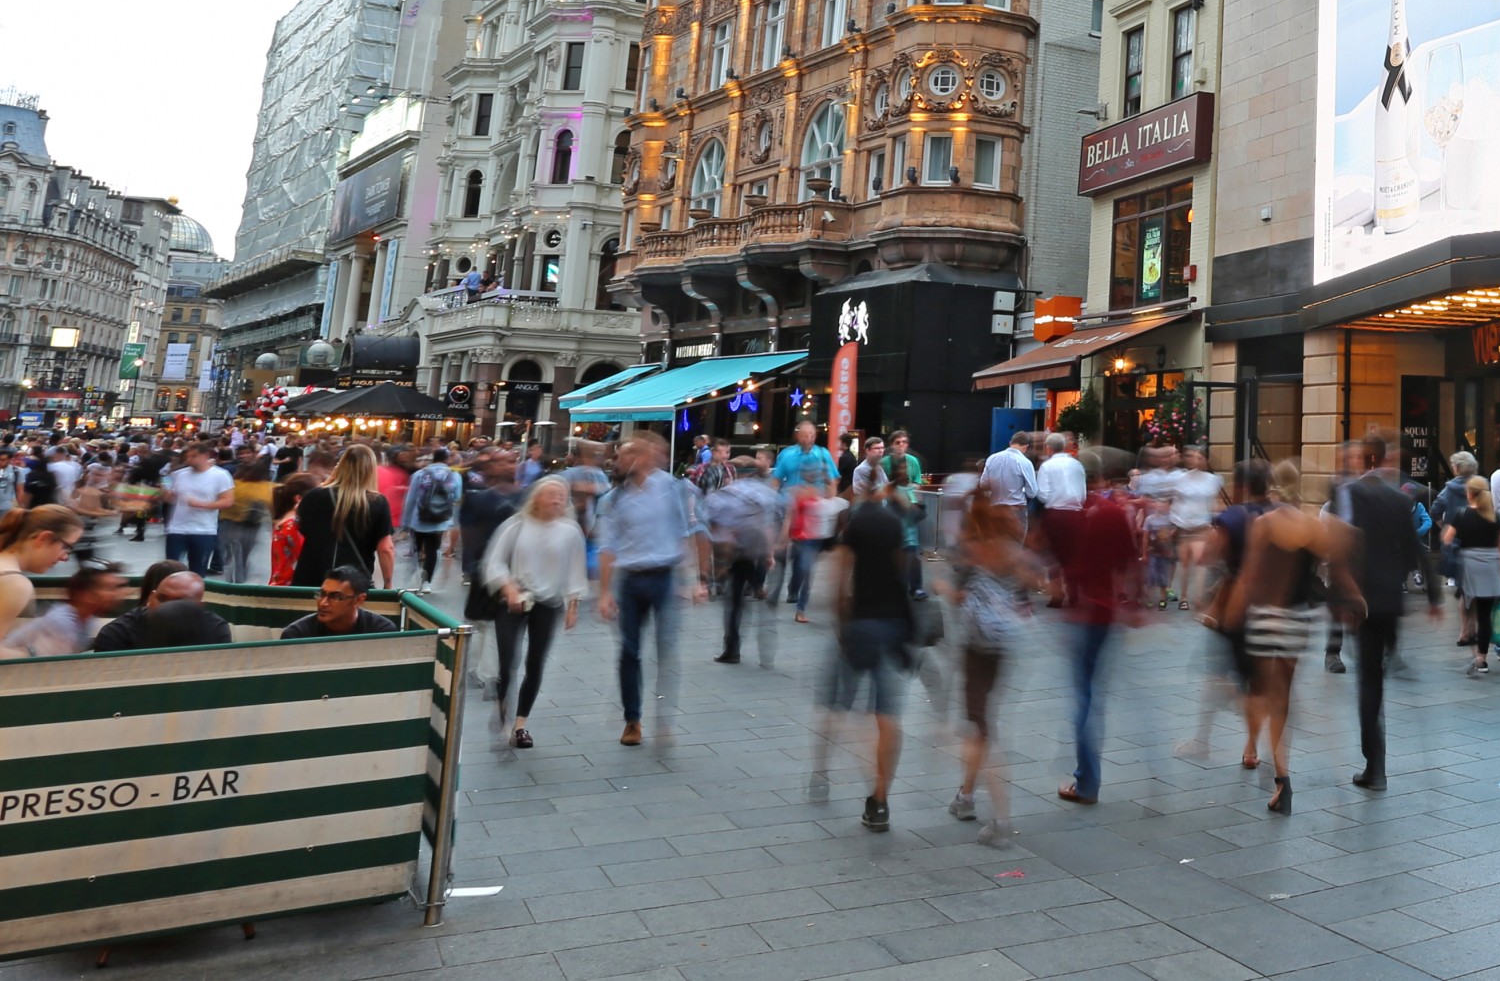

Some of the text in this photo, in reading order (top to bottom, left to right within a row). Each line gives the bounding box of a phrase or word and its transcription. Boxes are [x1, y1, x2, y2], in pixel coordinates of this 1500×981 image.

[1086, 110, 1189, 168] BELLA ITALIA
[1413, 438, 1428, 448] PIE
[0, 782, 139, 820] PRESSO
[172, 770, 239, 801] BAR
